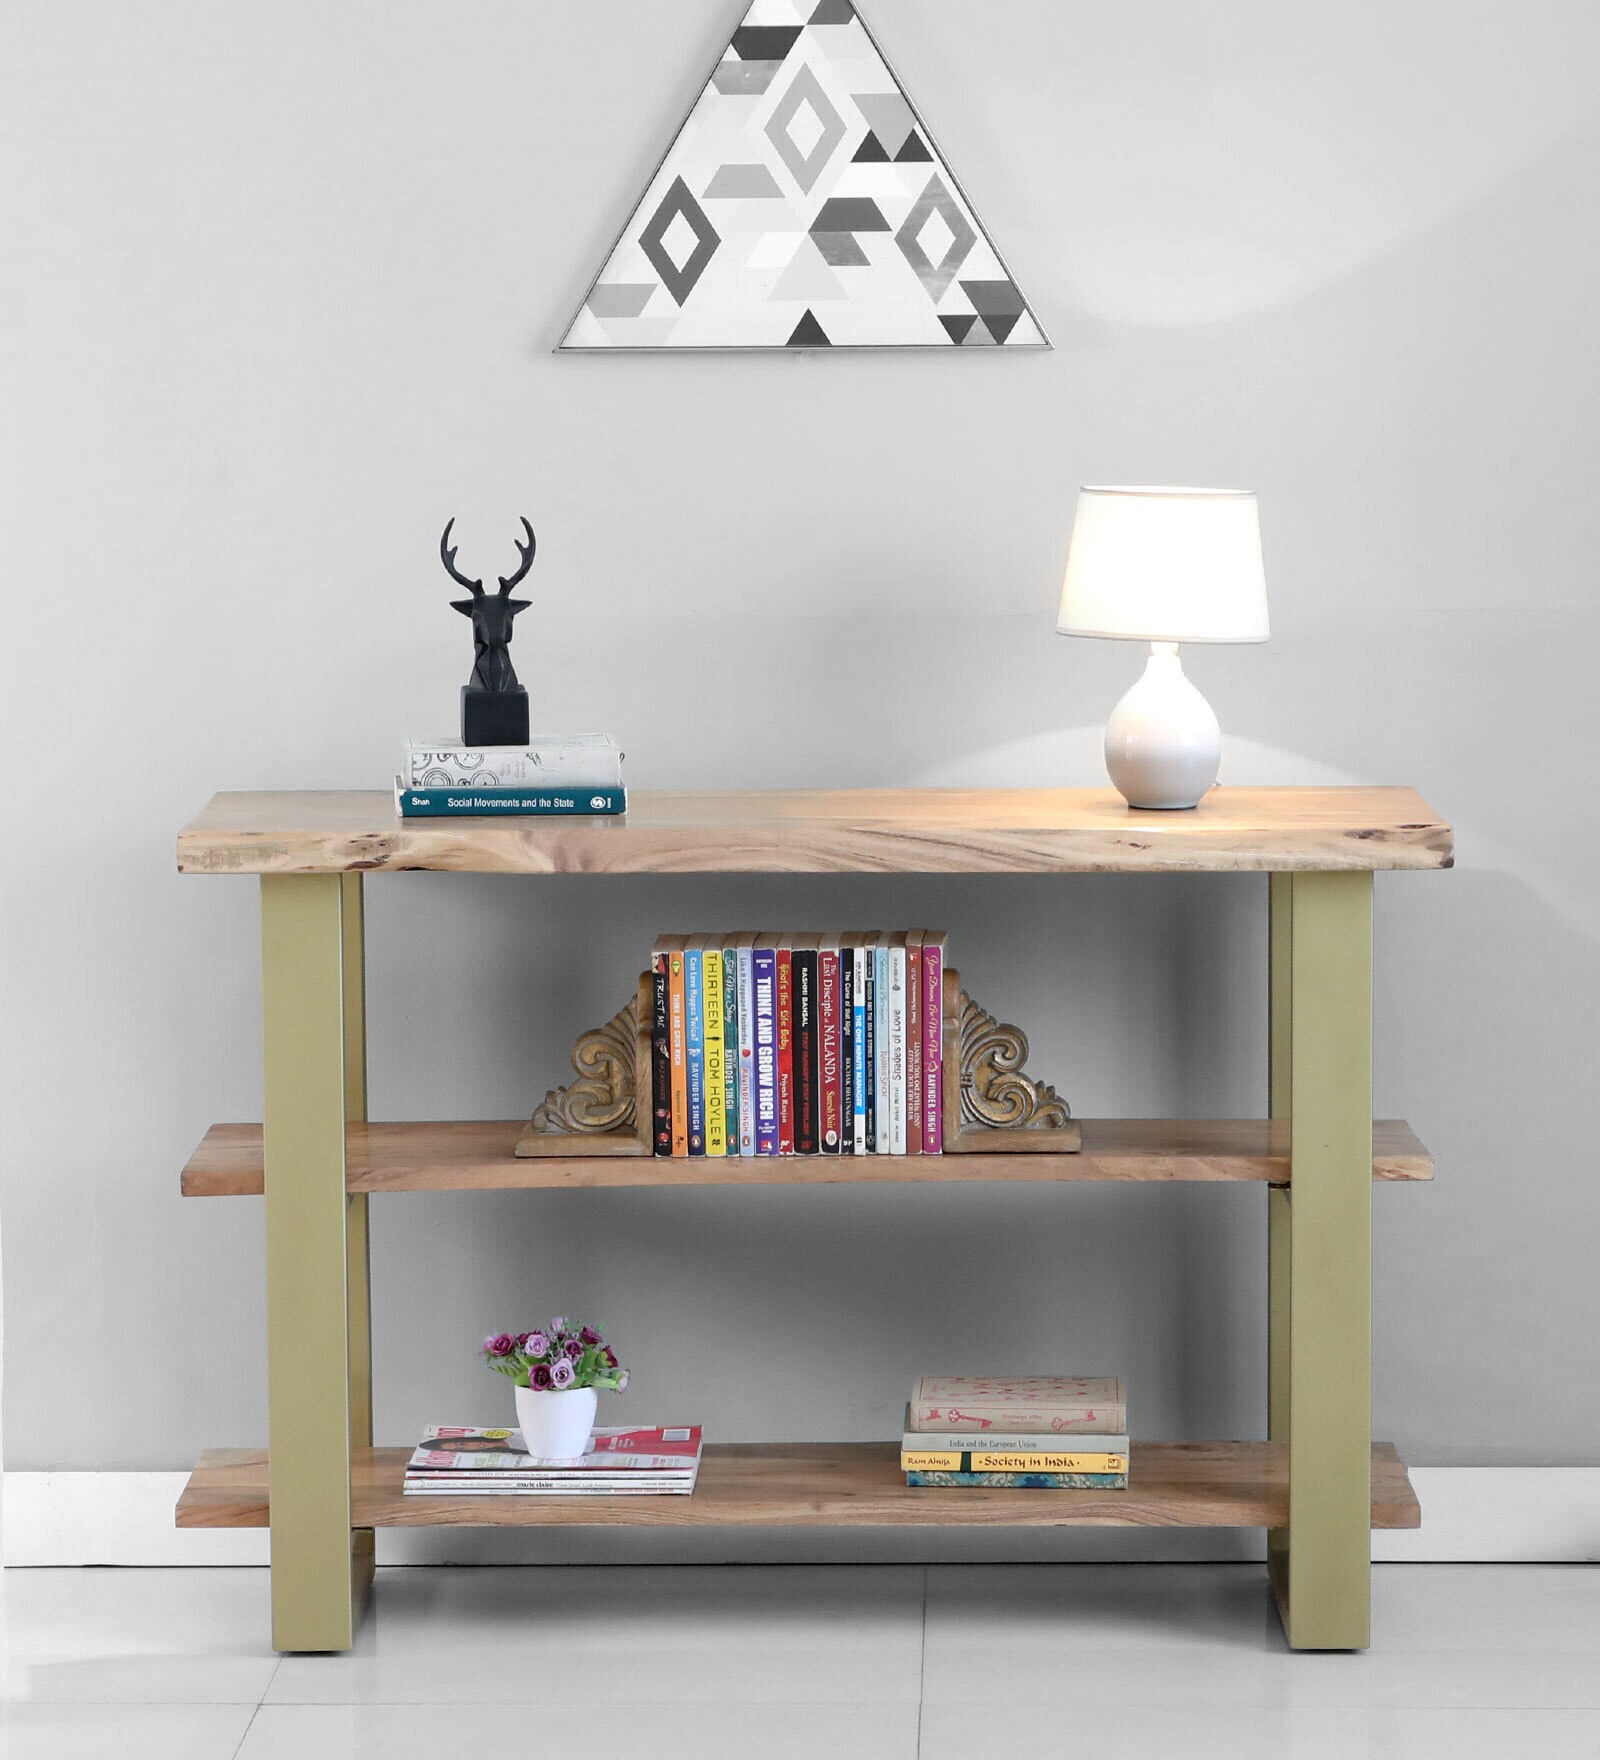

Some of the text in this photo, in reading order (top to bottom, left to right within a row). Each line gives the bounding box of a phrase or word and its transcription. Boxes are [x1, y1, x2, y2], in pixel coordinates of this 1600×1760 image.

[447, 798, 472, 808] Social
[474, 798, 519, 808] Movements
[521, 798, 537, 808] and
[538, 798, 552, 808] the
[553, 798, 574, 808] State
[823, 957, 833, 977] Last
[657, 978, 665, 1013] TRUST
[689, 989, 697, 1016] Happen
[757, 976, 772, 1016] THINK
[821, 979, 833, 1017] Disciple
[673, 1030, 681, 1047] GROW
[691, 1016, 699, 1041] Twice?
[707, 953, 720, 1135] THIRTEEN TOM HOYLE
[740, 1013, 748, 1045] Yesterday
[758, 1017, 773, 1044] AND
[824, 1024, 836, 1084] NALANDA
[892, 1009, 901, 1081] Shades of Love
[725, 1049, 734, 1110] RAVINDER SINGH
[758, 1046, 773, 1087] GROW
[691, 1062, 700, 1131] RAVINDER SINGH
[914, 1080, 920, 1091] DO
[759, 1088, 774, 1120] RICH
[780, 1099, 788, 1123] Ranjan
[826, 1090, 835, 1129] Suresh Nair
[927, 1074, 936, 1133] RAVINDER SINGH
[742, 1108, 750, 1132] SINGH
[949, 1440, 1037, 1449] India and the European Union
[928, 1457, 950, 1466] Ahuja
[984, 1456, 1074, 1468] Society in India
